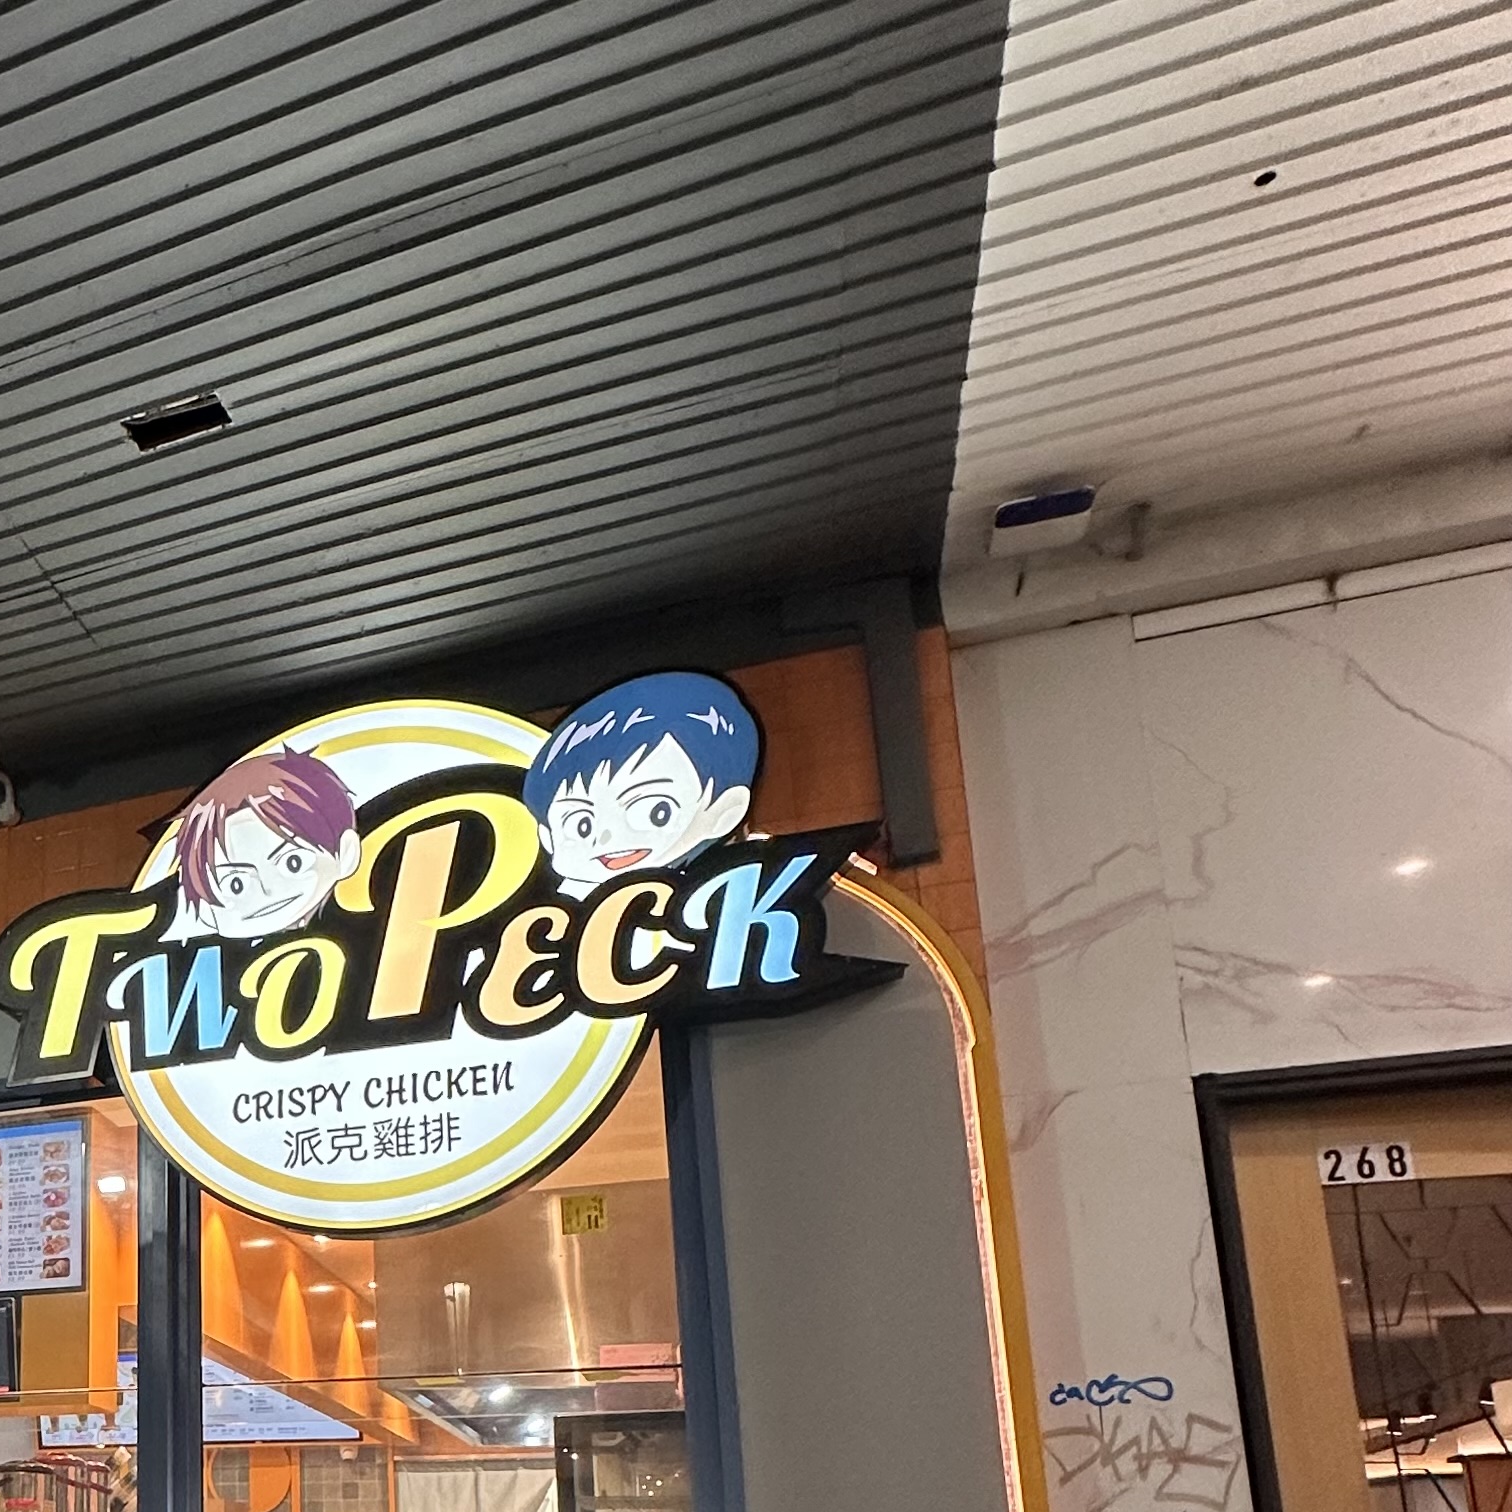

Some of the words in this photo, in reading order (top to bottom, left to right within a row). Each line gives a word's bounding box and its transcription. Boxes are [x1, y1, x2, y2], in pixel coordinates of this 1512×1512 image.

[232, 1080, 351, 1123] CRISPY
[363, 1061, 515, 1109] CHICKEN
[283, 1112, 462, 1169] 派克雞排
[1324, 1145, 1407, 1181] 268
